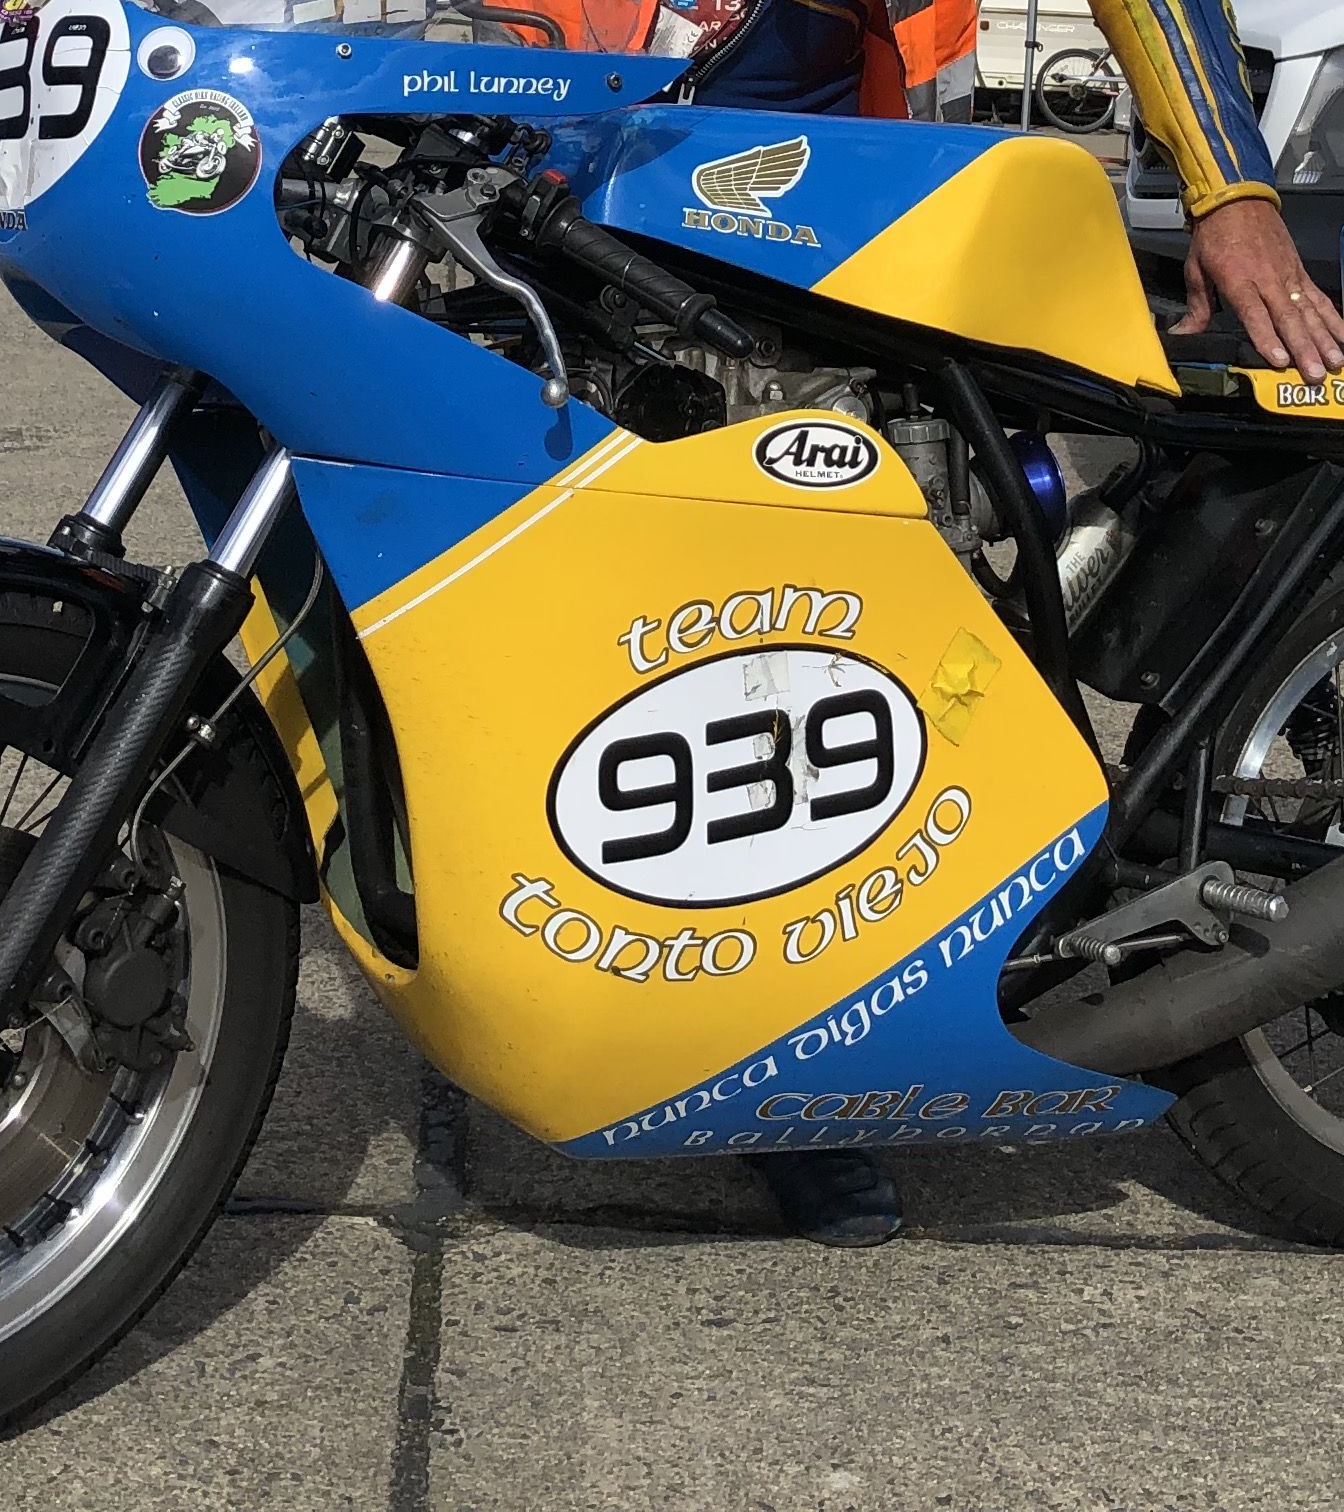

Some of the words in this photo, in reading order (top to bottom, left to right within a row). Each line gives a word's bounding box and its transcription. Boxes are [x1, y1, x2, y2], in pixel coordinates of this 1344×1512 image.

[682, 207, 821, 248] HONDA
[763, 429, 864, 469] Arai
[795, 471, 841, 479] HELMET
[1065, 551, 1087, 574] THE
[617, 584, 864, 673] team
[597, 688, 896, 865] 939
[499, 872, 757, 983] tonto
[602, 1055, 779, 1145] nunca
[938, 828, 1086, 968] nunca
